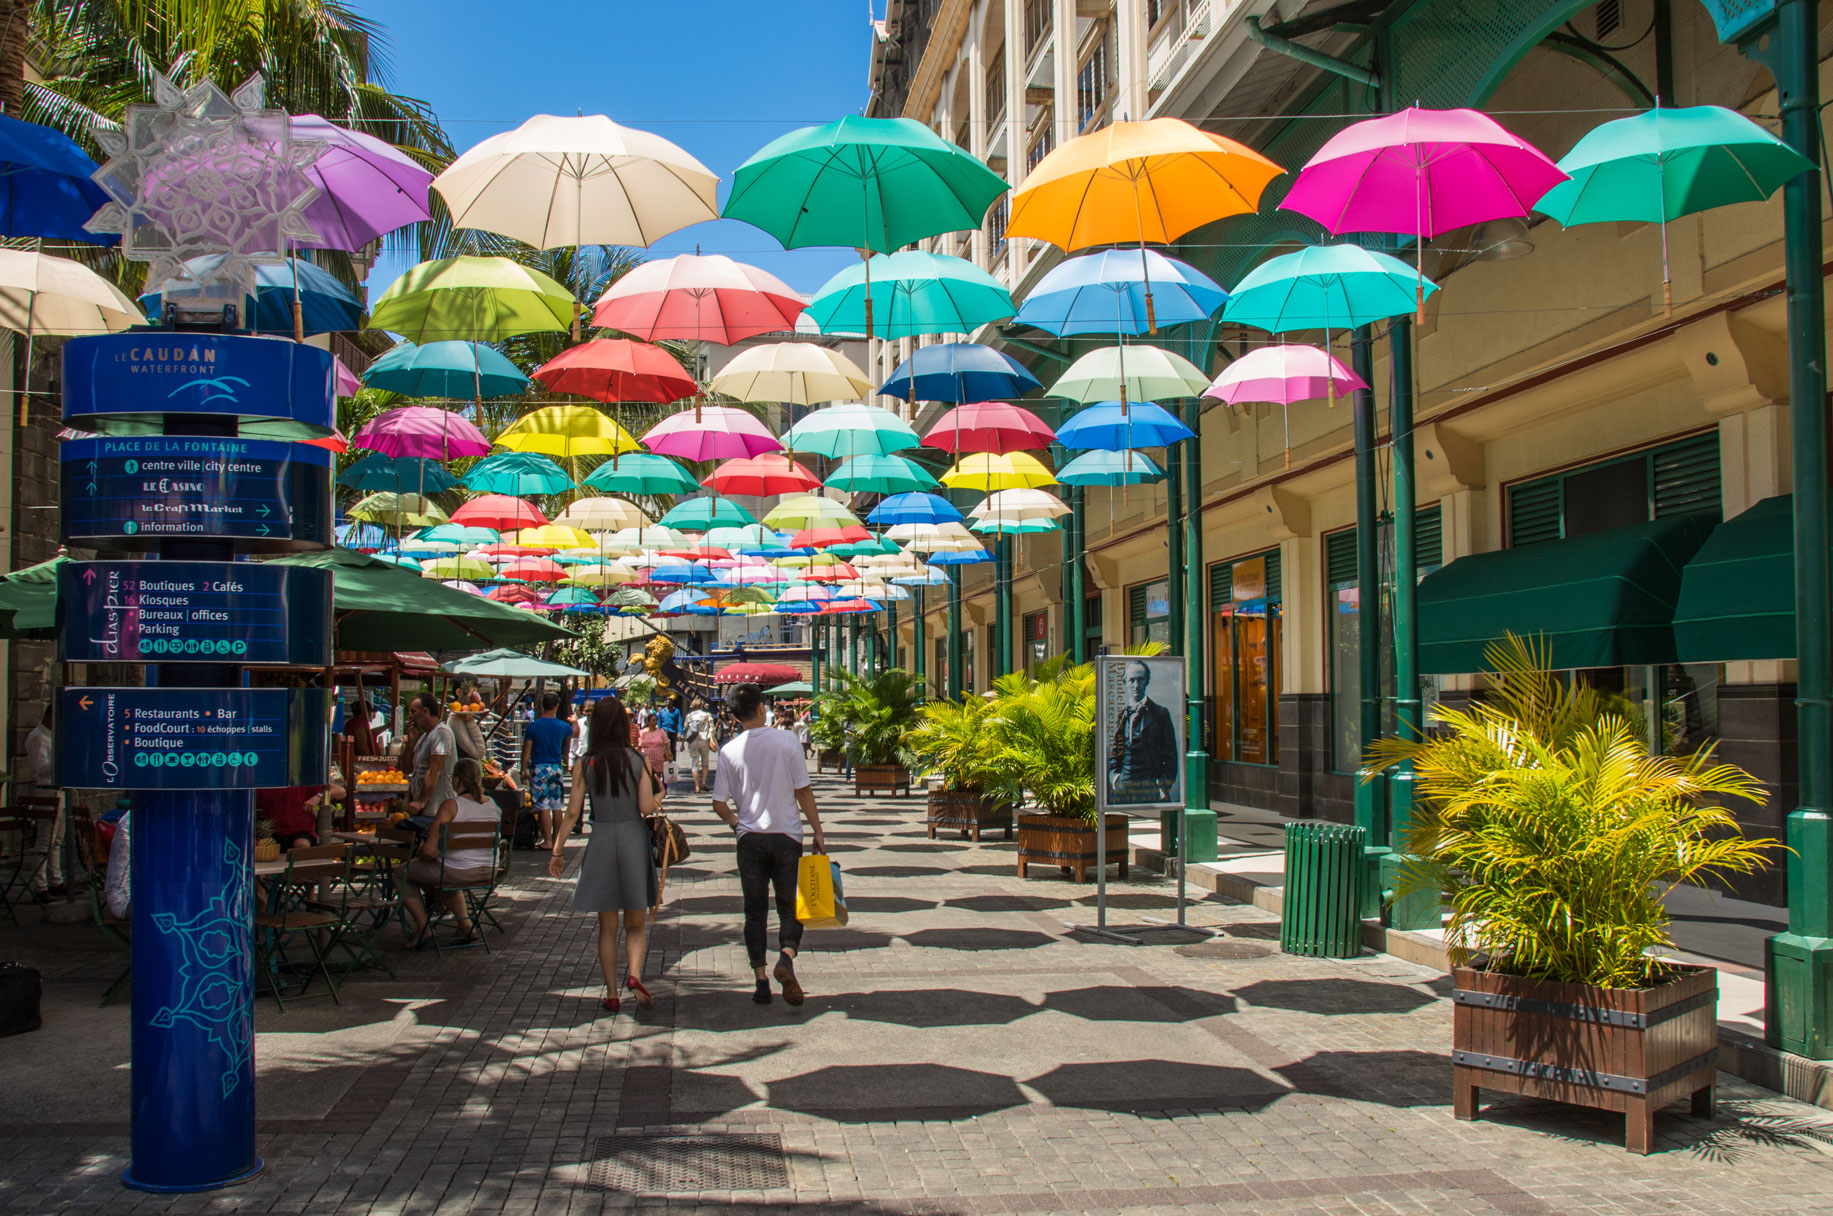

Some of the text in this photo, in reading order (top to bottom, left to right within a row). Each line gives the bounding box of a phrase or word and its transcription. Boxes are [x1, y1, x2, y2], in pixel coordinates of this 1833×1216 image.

[115, 348, 216, 363] LE CAUDAN
[130, 364, 215, 375] WATERFRONT
[105, 442, 247, 454] PLACE DE LA FONTAINE
[141, 460, 262, 473] centre ville city centre
[143, 478, 204, 494] LE CASINO
[189, 503, 243, 514] Market
[141, 522, 204, 532] information
[122, 580, 244, 592] 52 Boutiques 2 Cafés
[123, 595, 189, 607] 16 Kiosques
[139, 609, 228, 621] Bureaux offices
[139, 624, 180, 636] Parking
[124, 708, 237, 719] 5 Restaurants Bar
[134, 723, 190, 734] FoodCourt
[196, 726, 205, 734] 10
[207, 724, 246, 736] échoppes
[251, 725, 273, 734] stalls
[134, 737, 184, 749] Boutique
